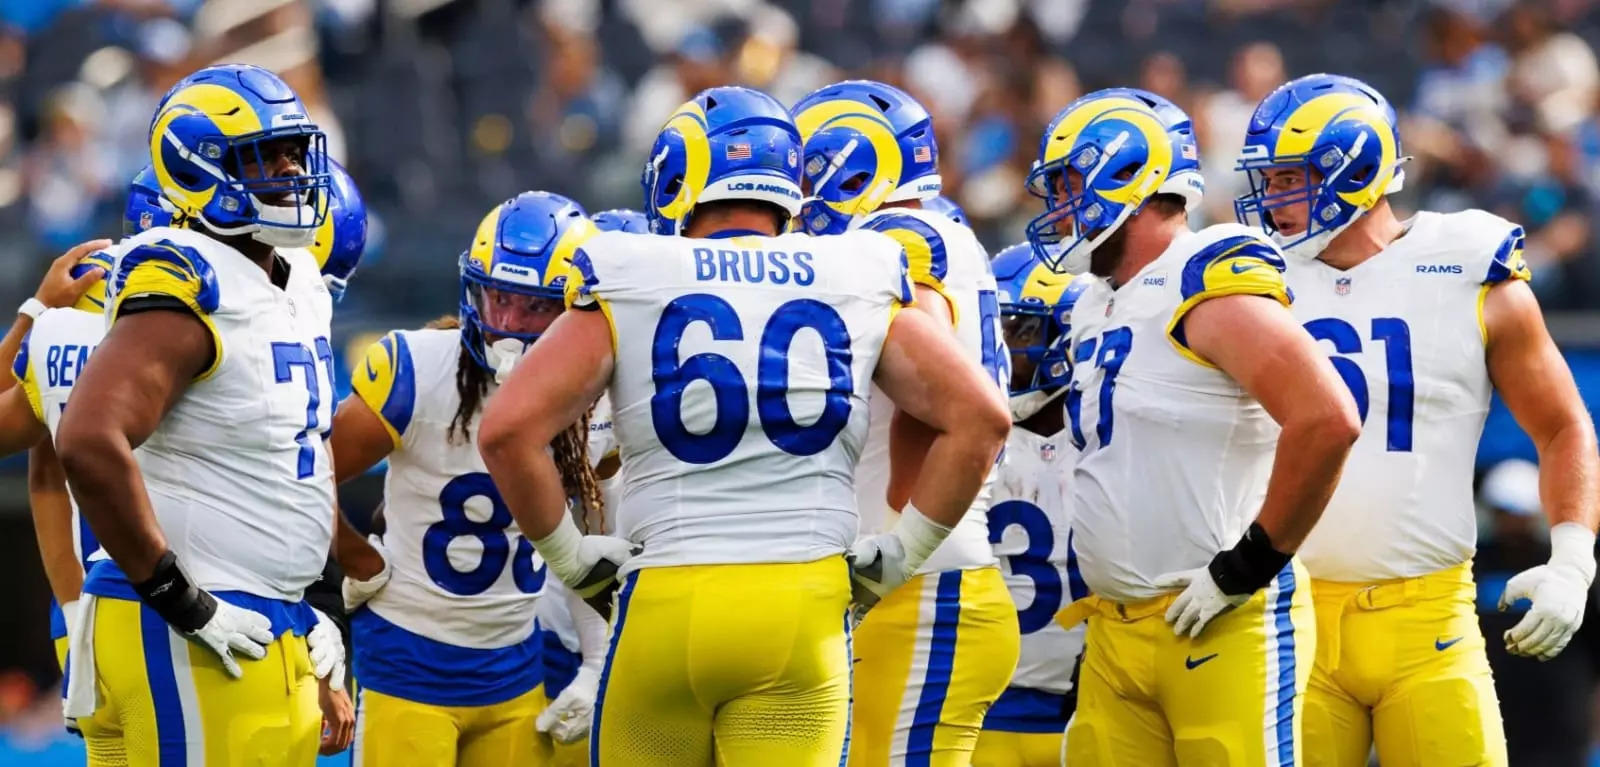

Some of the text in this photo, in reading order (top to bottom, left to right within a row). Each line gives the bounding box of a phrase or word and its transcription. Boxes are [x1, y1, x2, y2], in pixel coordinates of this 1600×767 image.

[693, 248, 815, 286] BRUSS
[1416, 264, 1463, 274] RAMS
[650, 292, 854, 465] 60
